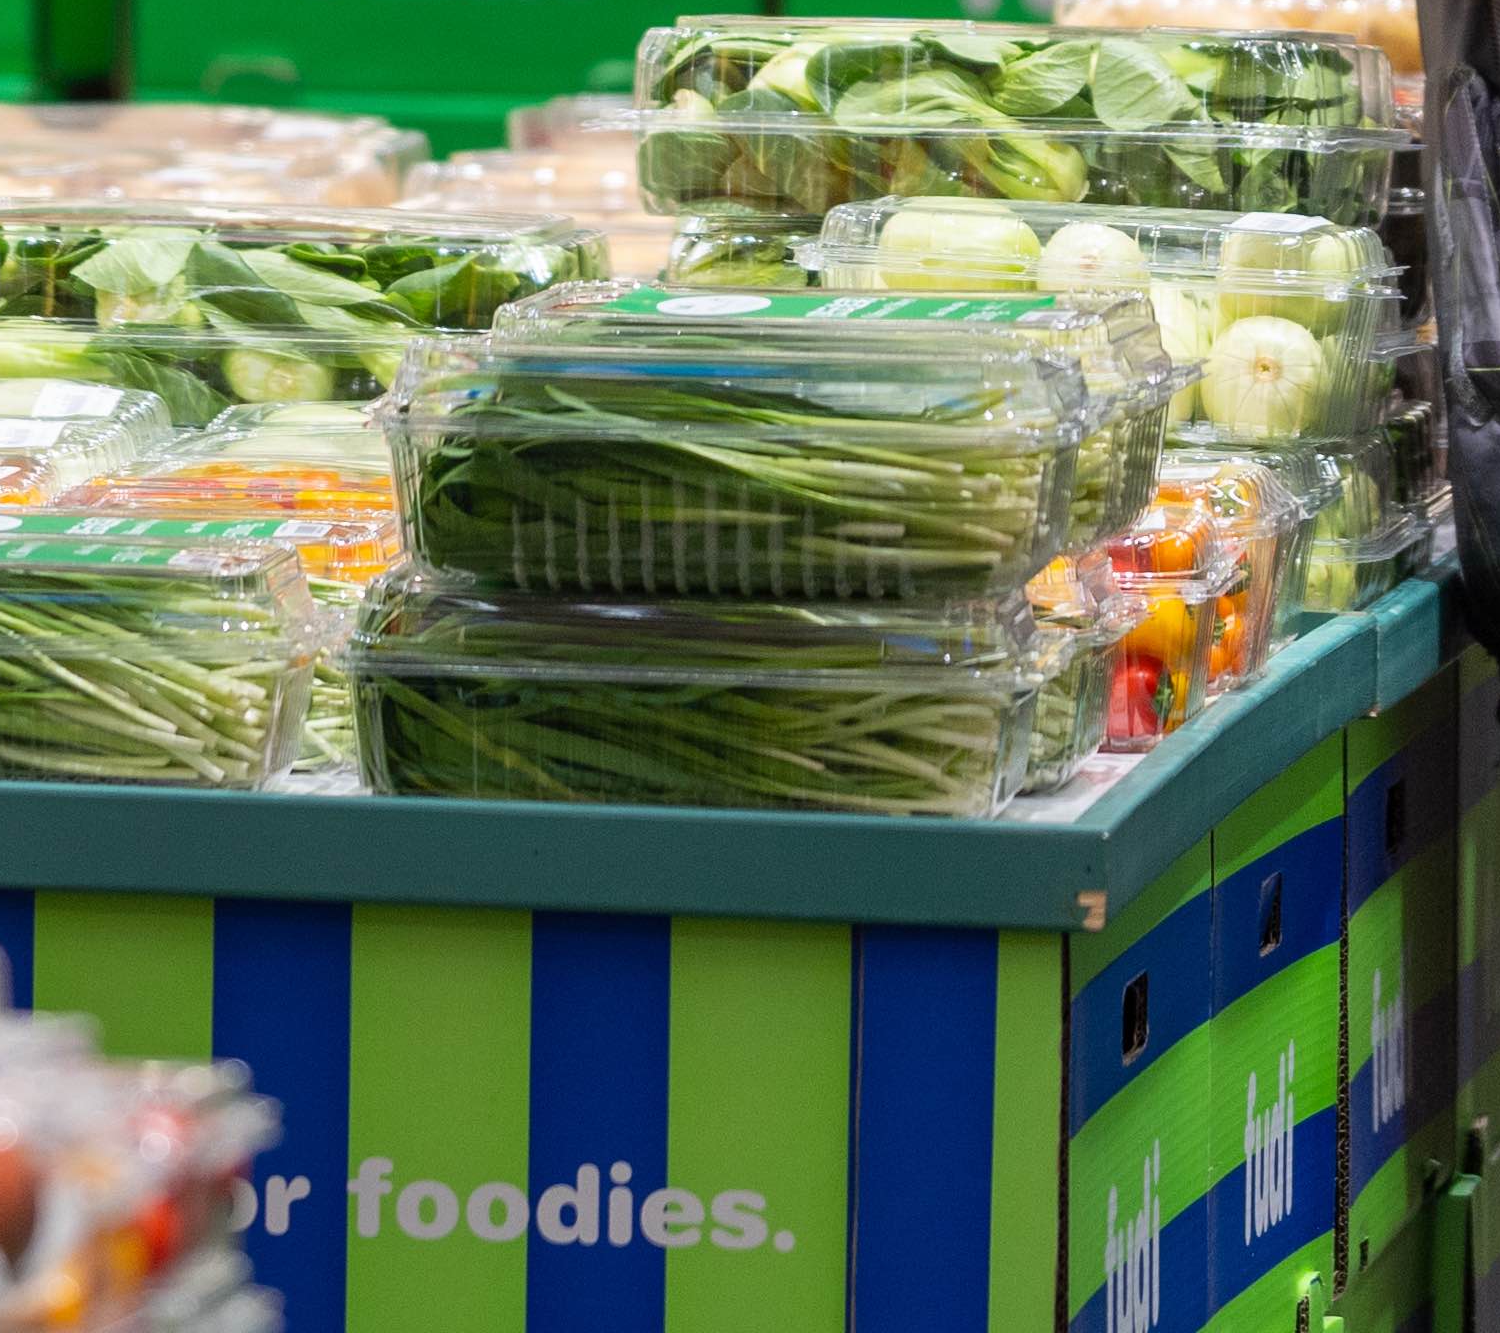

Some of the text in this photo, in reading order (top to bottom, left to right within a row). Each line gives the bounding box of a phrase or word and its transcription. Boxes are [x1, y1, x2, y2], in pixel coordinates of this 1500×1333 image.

[346, 1156, 796, 1252] foodies.
[1105, 1138, 1160, 1333] fudi
[1243, 1039, 1294, 1246] fudi
